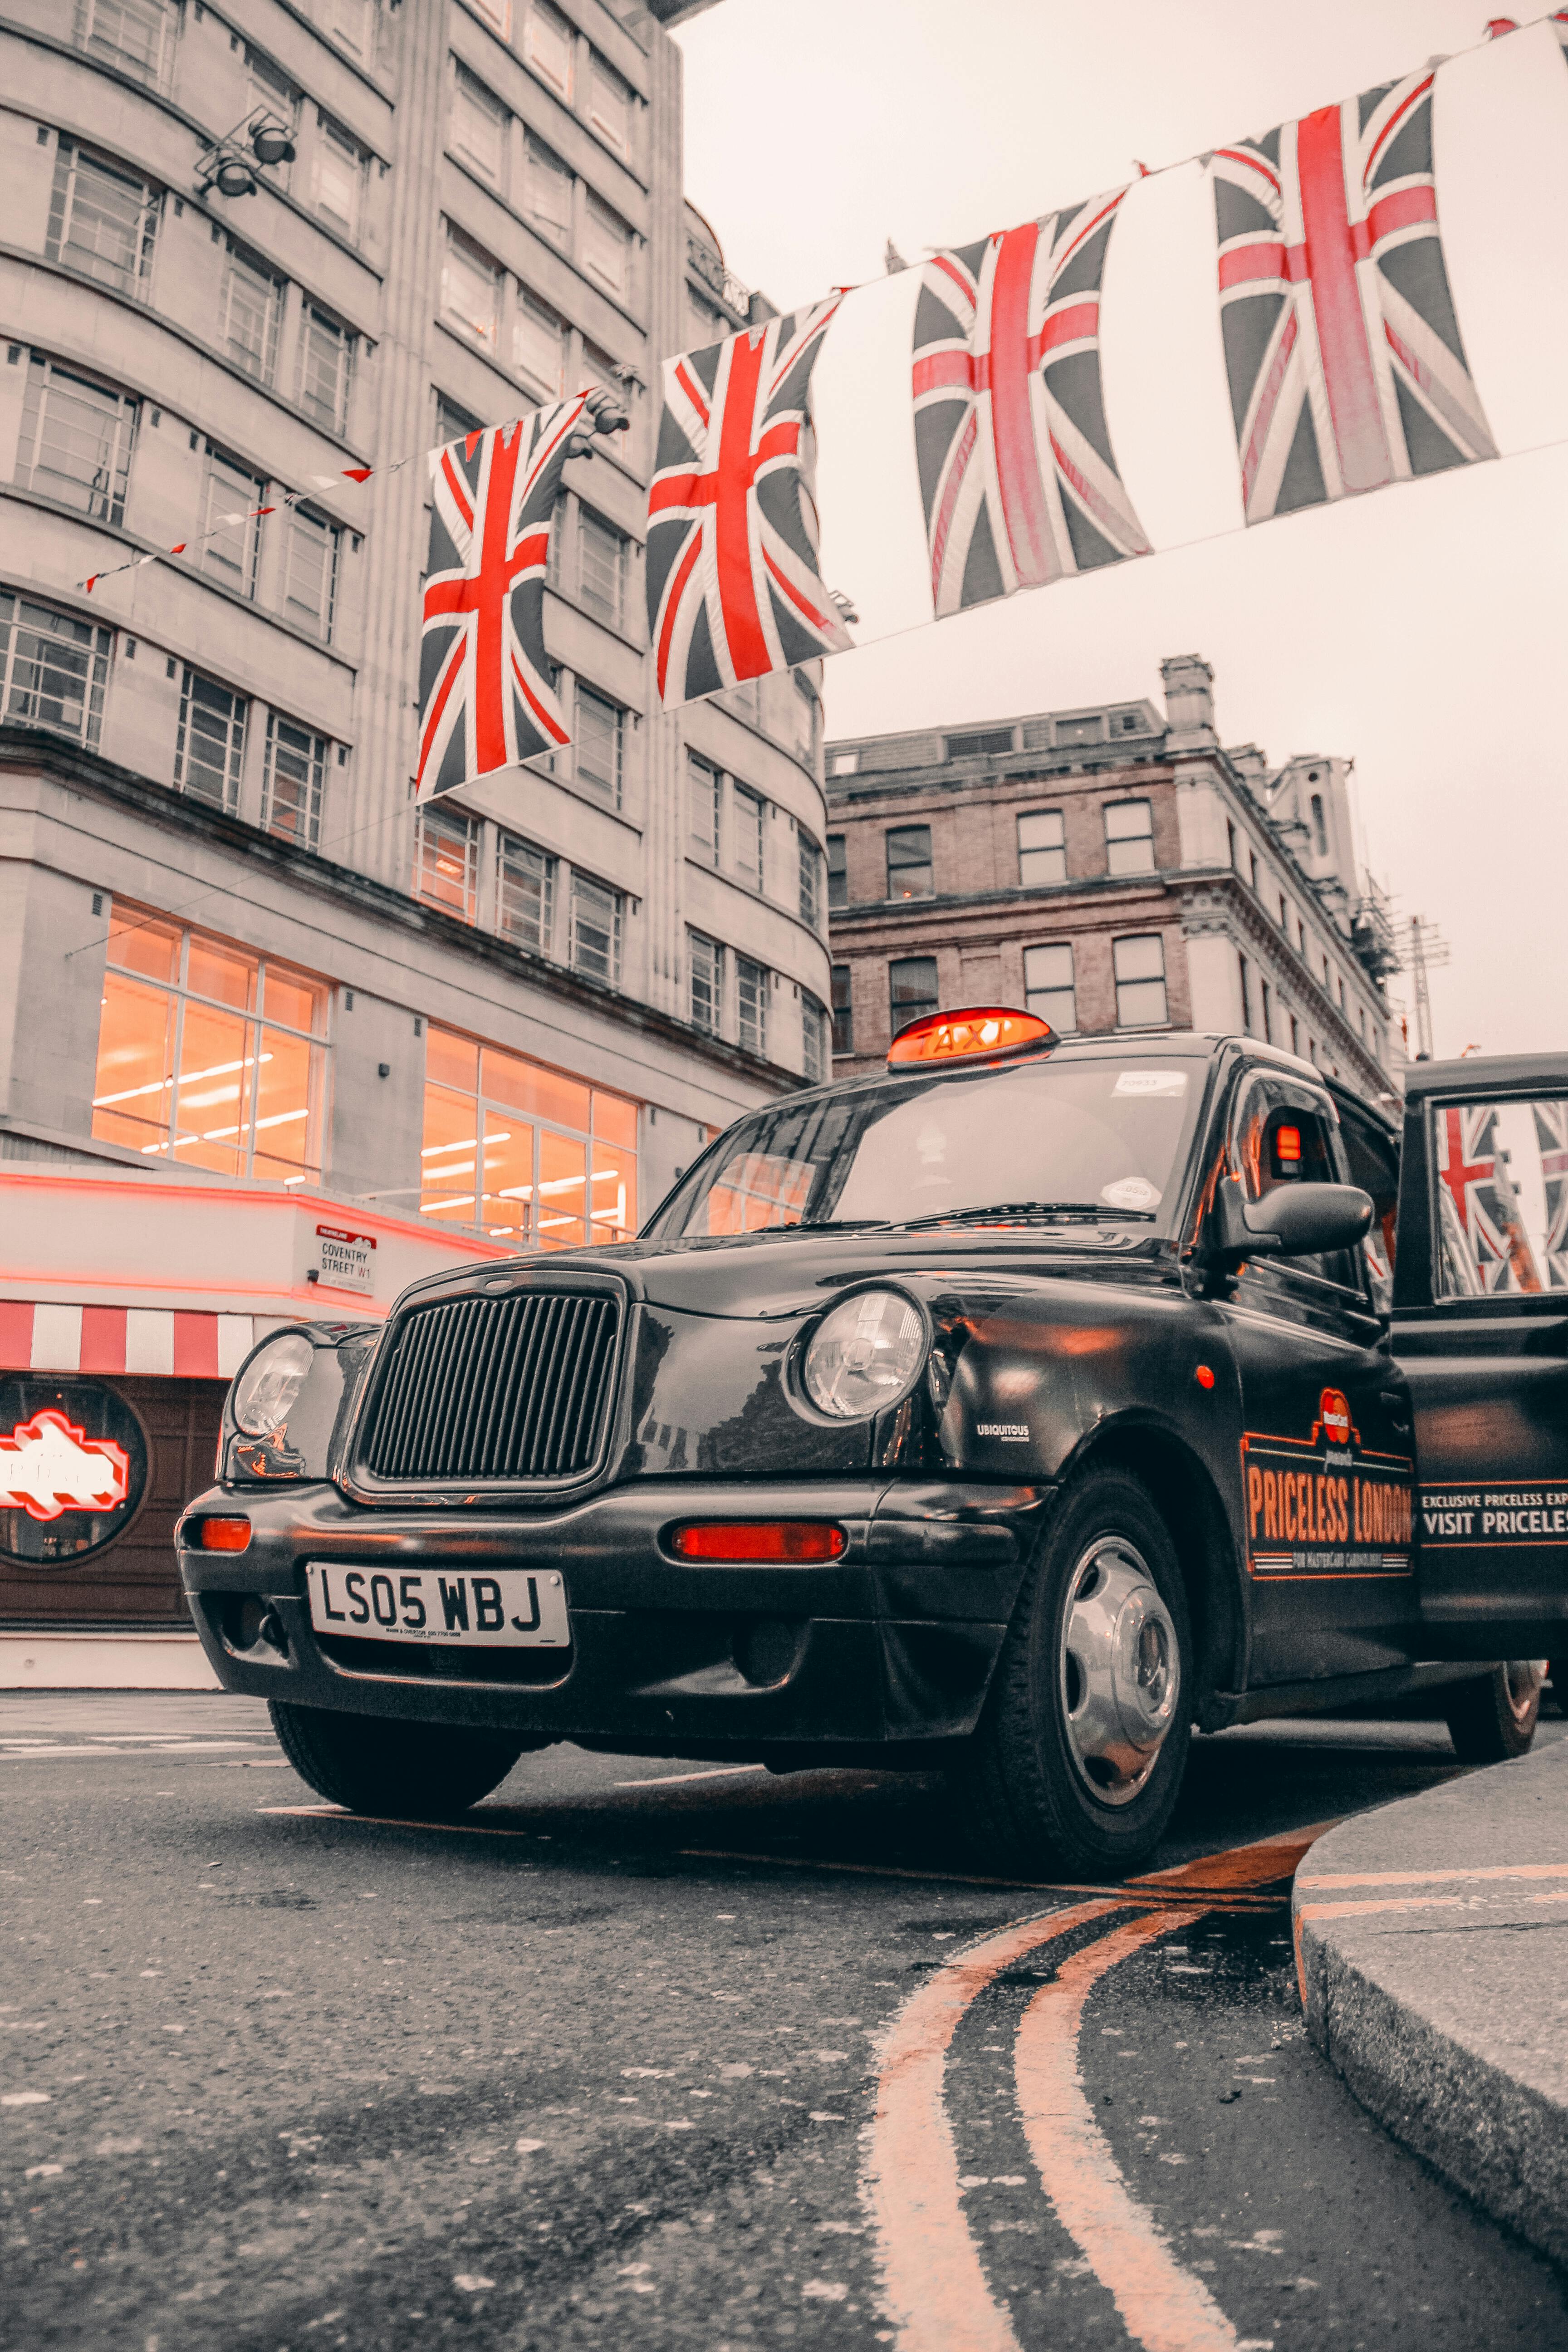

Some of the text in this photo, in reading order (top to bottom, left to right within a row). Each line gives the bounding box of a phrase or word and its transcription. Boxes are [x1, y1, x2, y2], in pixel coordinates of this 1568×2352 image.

[918, 1021, 1002, 1055] TAXI
[323, 1243, 367, 1263] COVENTRY
[322, 1258, 370, 1278] STREET W1
[977, 1425, 1029, 1436] UBIQUITOUS
[1248, 1465, 1411, 1543] PRICELESS LONDON
[1422, 1494, 1481, 1508] EXCLUSIVE
[1484, 1493, 1543, 1506] PRICELESS
[1423, 1510, 1568, 1534] VISIT PRICELES
[321, 1569, 541, 1632] LS05 WBJ
